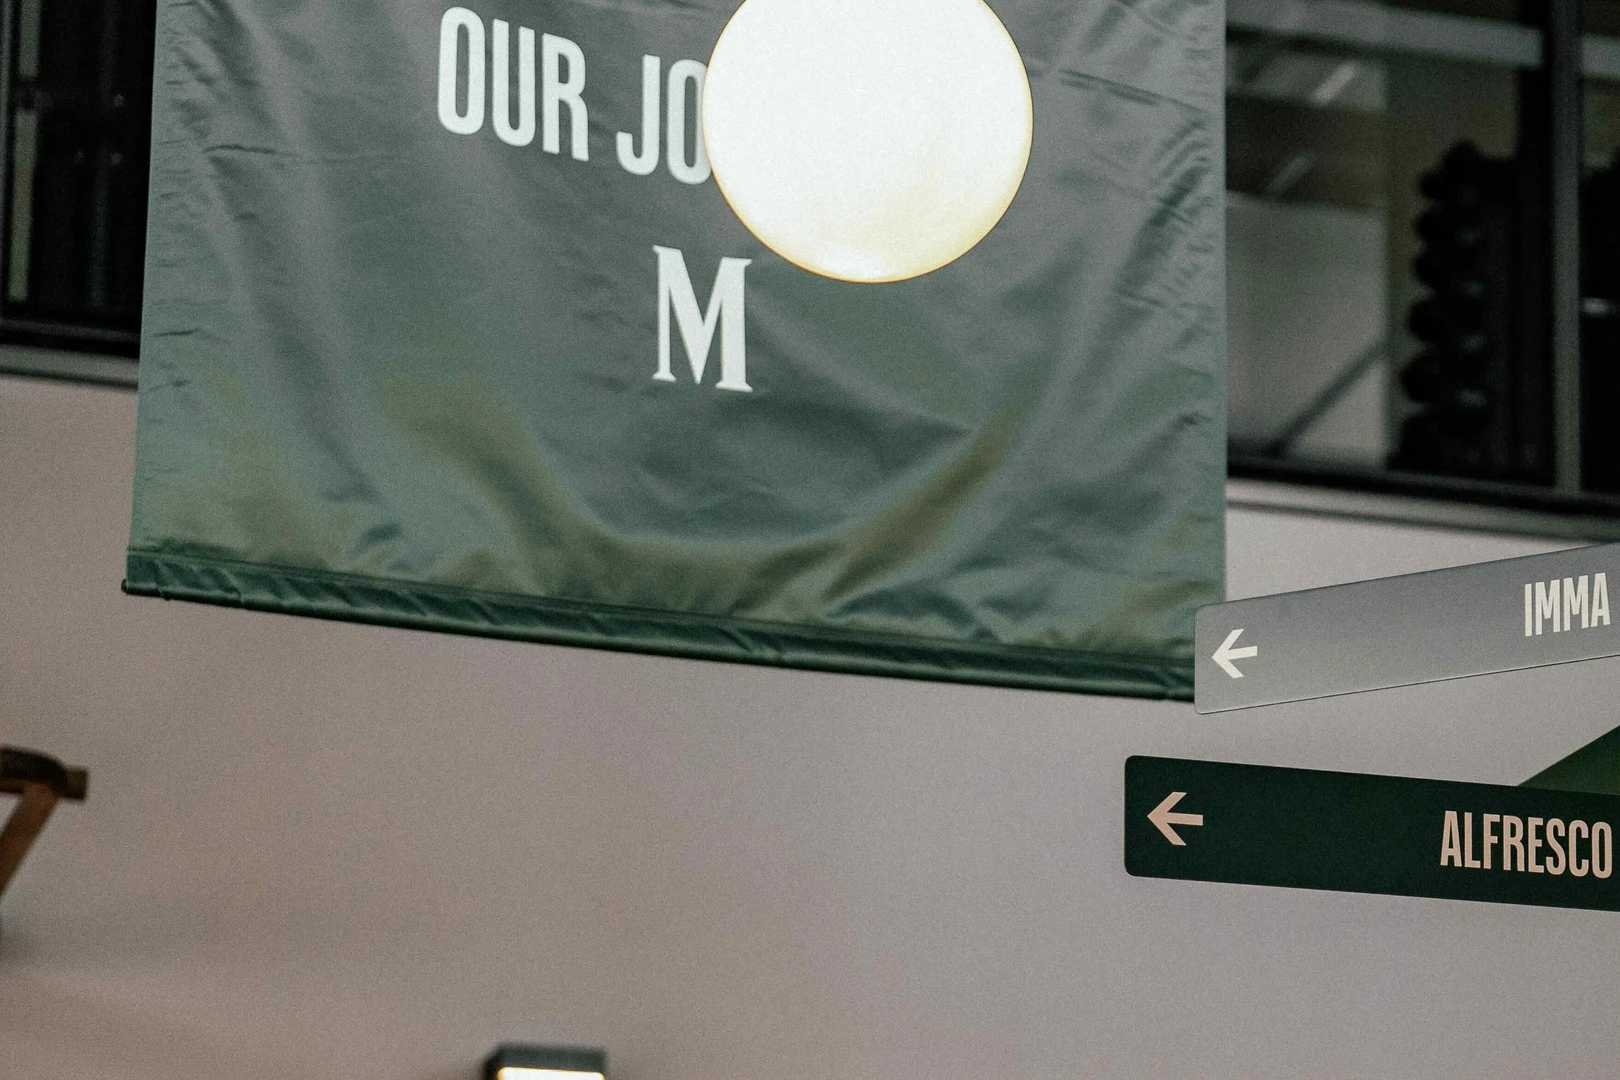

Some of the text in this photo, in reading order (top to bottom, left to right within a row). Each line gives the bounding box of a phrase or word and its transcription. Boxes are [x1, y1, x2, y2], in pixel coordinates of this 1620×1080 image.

[437, 6, 589, 162] OUR
[653, 244, 754, 392] M
[1524, 572, 1611, 637] IMMA
[1440, 810, 1613, 879] ALFRESCO
